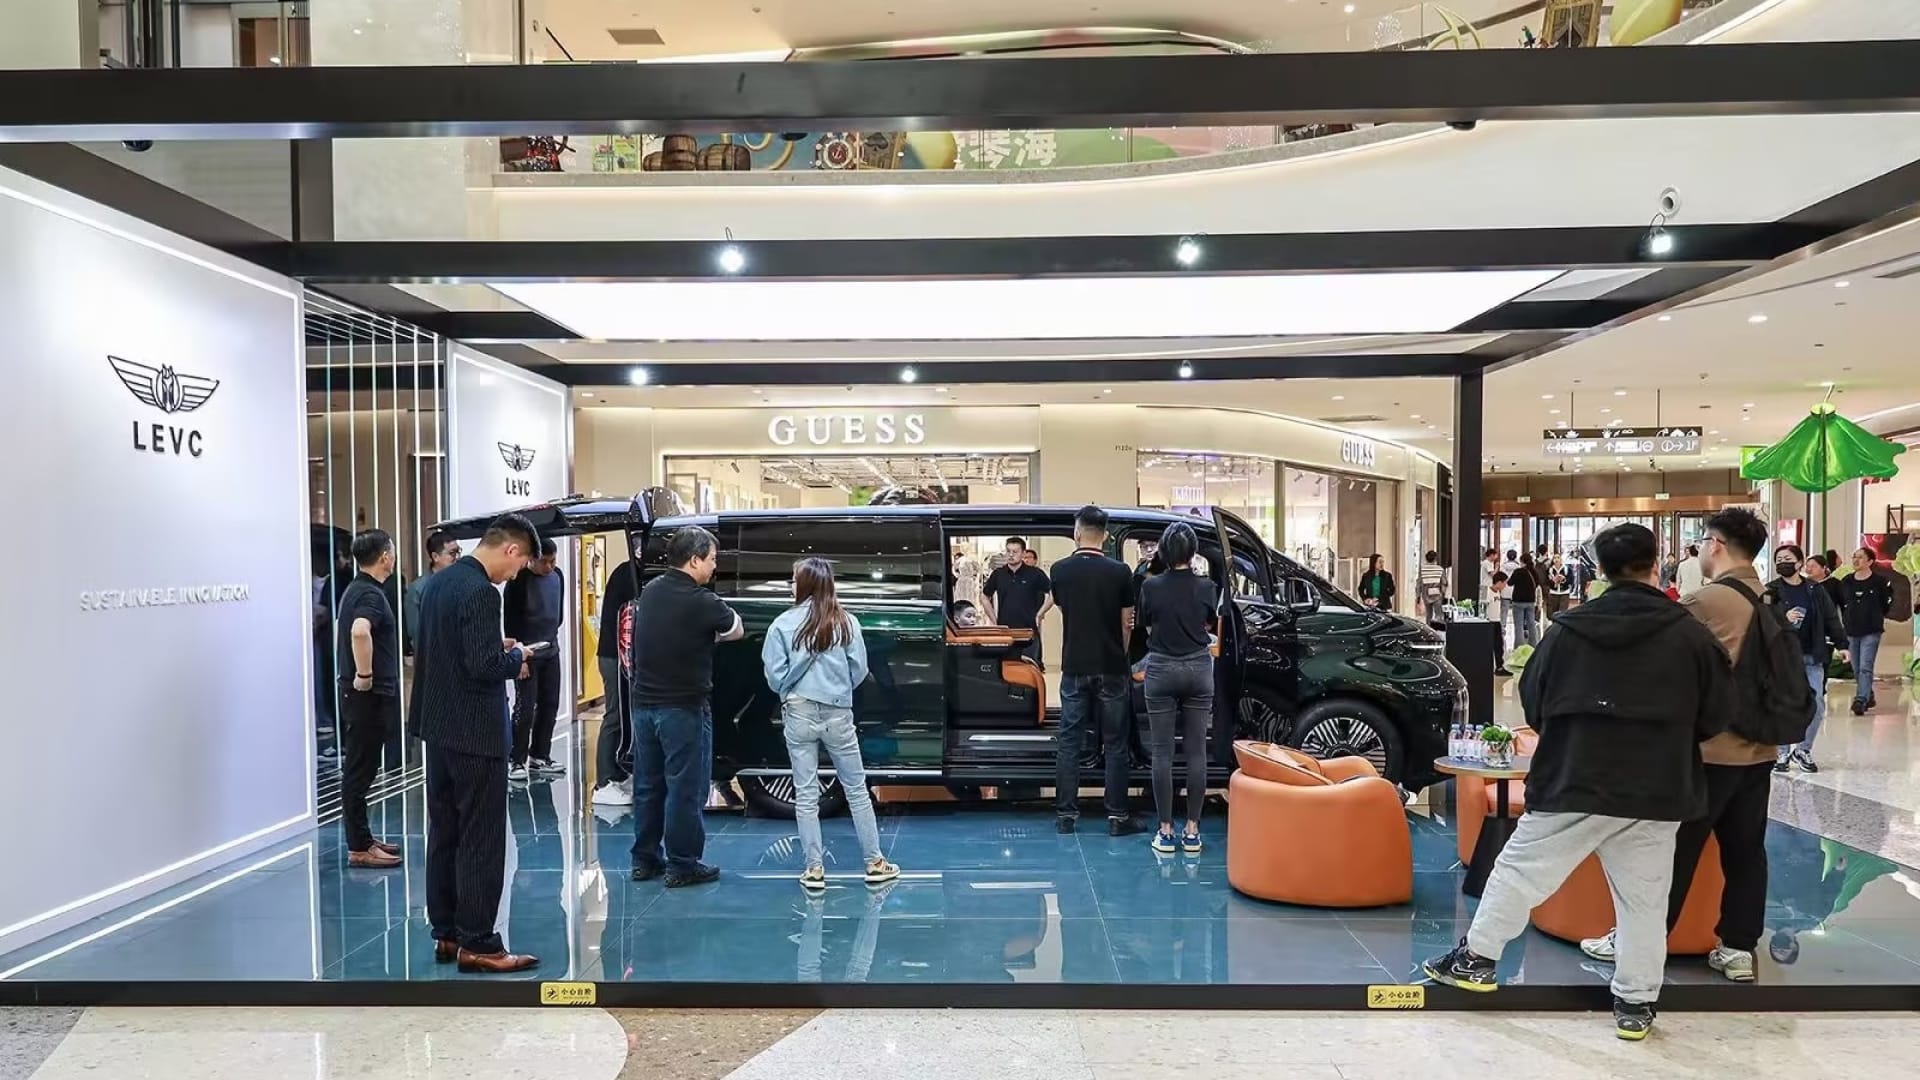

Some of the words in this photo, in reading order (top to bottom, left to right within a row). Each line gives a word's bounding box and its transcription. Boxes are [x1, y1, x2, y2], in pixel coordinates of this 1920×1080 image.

[132, 420, 203, 457] LEVC
[768, 413, 925, 445] GUESS
[1342, 438, 1375, 467] GUESS
[505, 477, 530, 497] LEVC
[79, 587, 177, 611] SUSTAINABLE
[178, 583, 250, 604] INNOVATION
